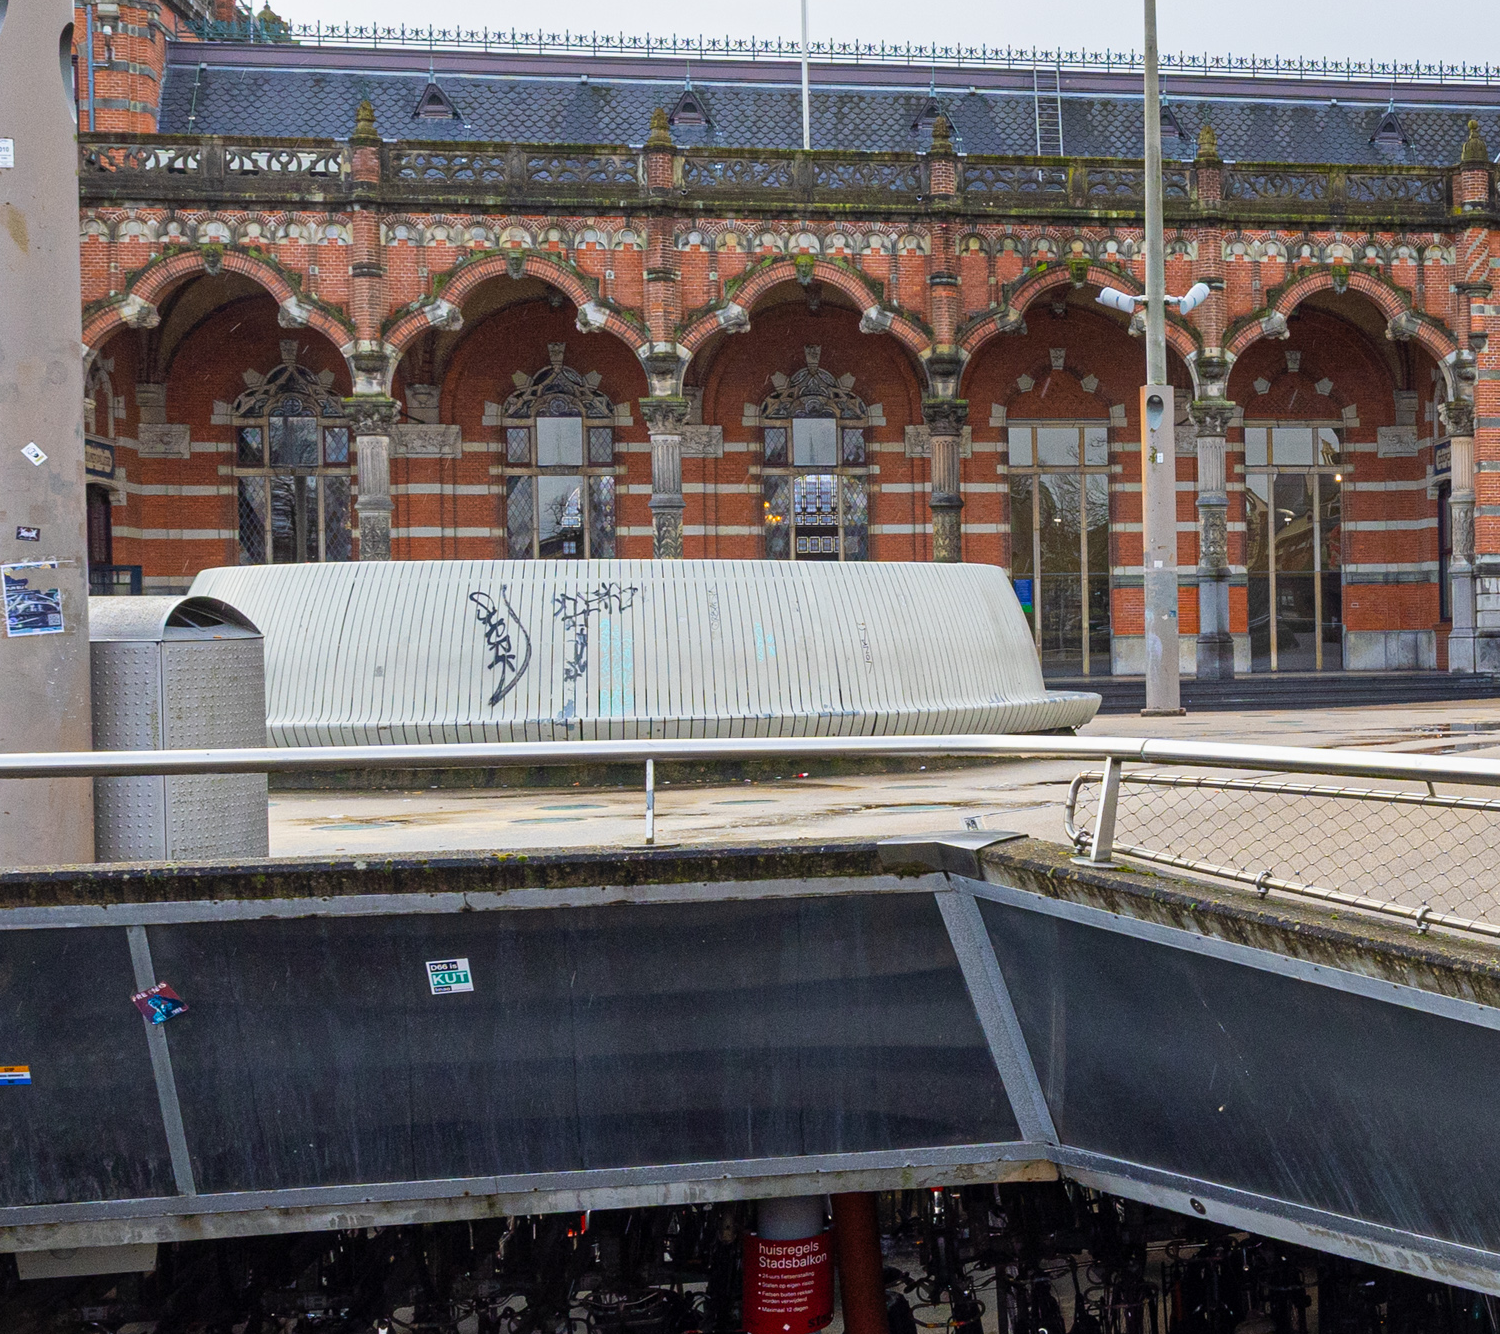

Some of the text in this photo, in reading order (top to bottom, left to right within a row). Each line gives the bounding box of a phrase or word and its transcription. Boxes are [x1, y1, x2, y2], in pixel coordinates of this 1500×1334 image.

[430, 963, 448, 971] D66
[432, 971, 467, 985] KUT
[758, 1241, 820, 1257] huisregels
[759, 1253, 827, 1269] Stadsbalkon
